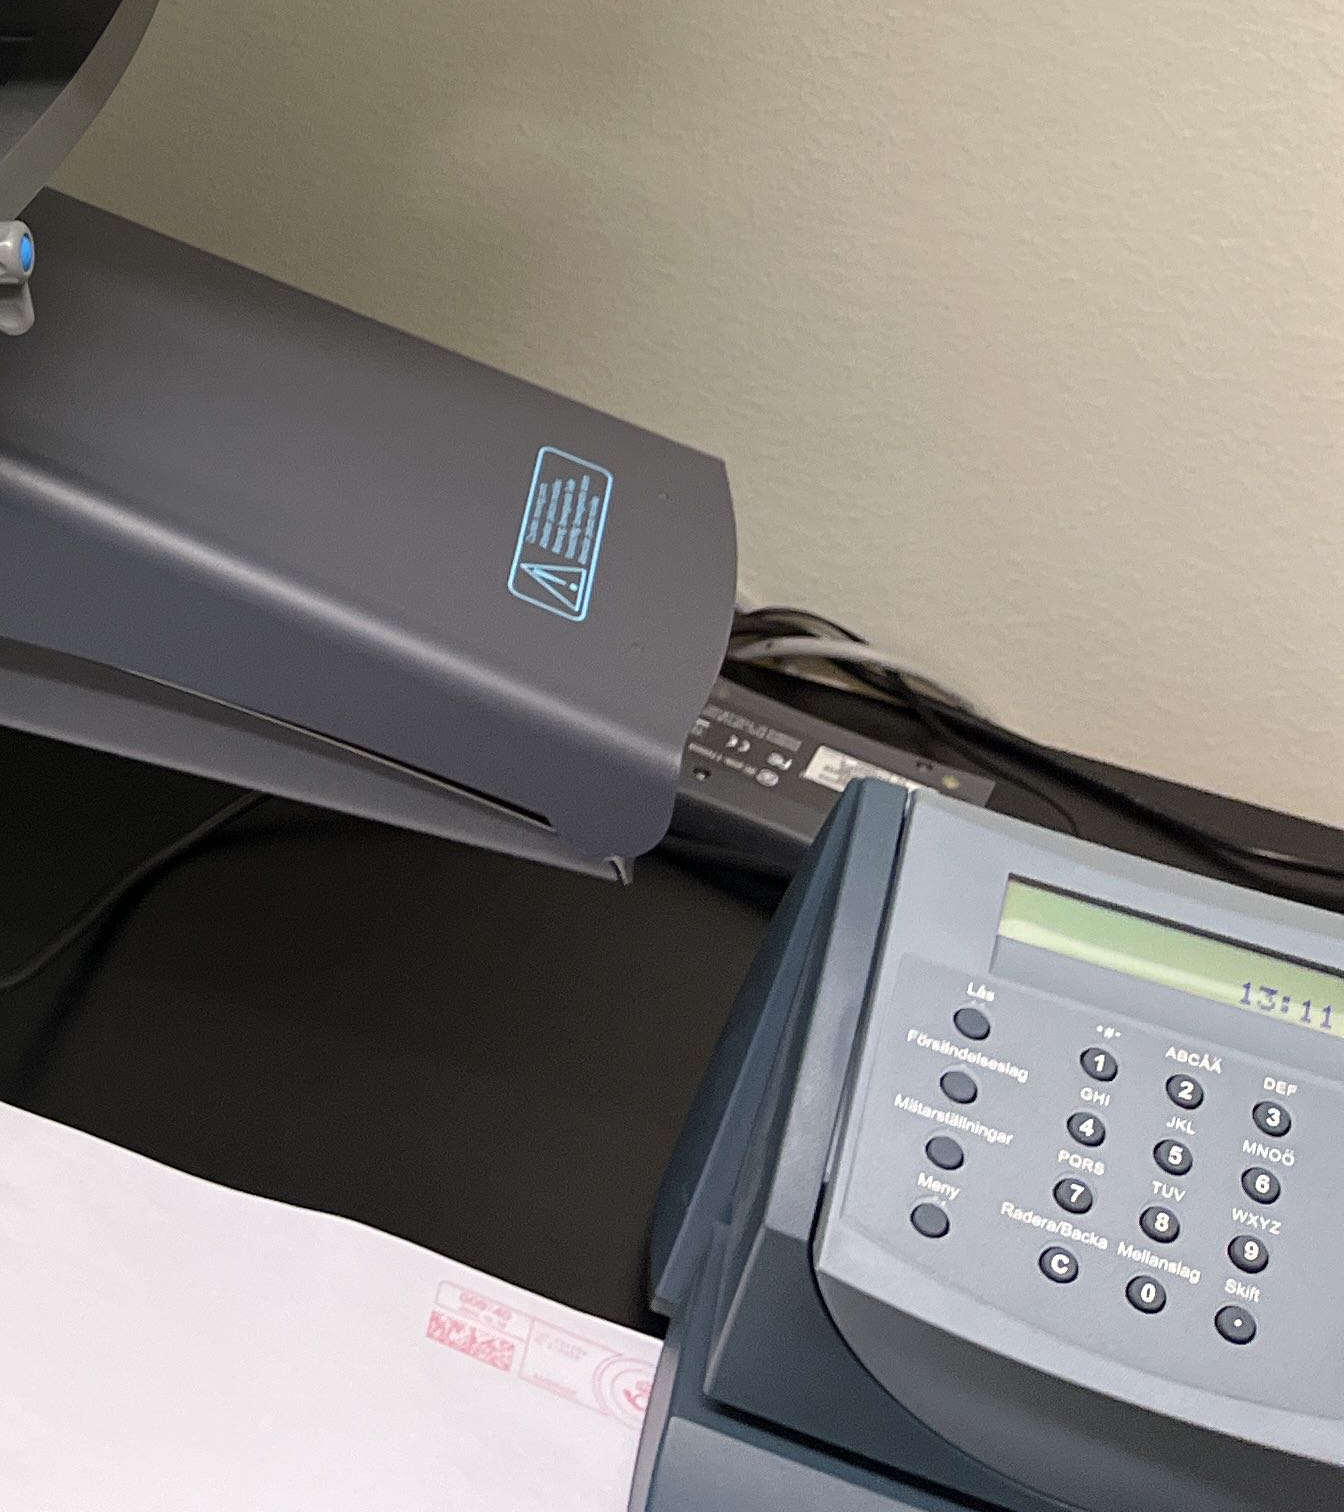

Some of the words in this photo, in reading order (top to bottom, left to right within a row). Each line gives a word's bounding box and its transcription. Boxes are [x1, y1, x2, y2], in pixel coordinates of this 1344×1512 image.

[967, 982, 995, 1002] Lås
[1239, 981, 1332, 1029] 13:11
[1094, 1054, 1105, 1072] 1
[1165, 1046, 1223, 1074] ABCÅÄ
[1178, 1081, 1194, 1100] 2
[1263, 1076, 1298, 1096] DEF
[1080, 1087, 1111, 1106] GHI
[894, 1094, 1014, 1145] Mätarställningar
[1078, 1118, 1095, 1137] 4
[1166, 1116, 1196, 1135] JKL
[1266, 1108, 1281, 1127] 3
[1058, 1149, 1105, 1176] PQRS
[1168, 1146, 1184, 1165] 5
[1242, 1140, 1295, 1167] MNOÖ
[918, 1173, 960, 1200] Meny
[1069, 1184, 1085, 1202] 7
[1152, 1180, 1186, 1202] TUV
[1255, 1175, 1270, 1193] 6
[1000, 1201, 1109, 1251] Radera/Backa
[1154, 1213, 1169, 1232] 8
[1231, 1207, 1282, 1236] WXYZ
[1243, 1241, 1258, 1261] 9
[1051, 1254, 1069, 1274] C
[1116, 1241, 1201, 1285] Mellanslag
[1141, 1283, 1156, 1303] 0
[1224, 1278, 1261, 1303] Skift
